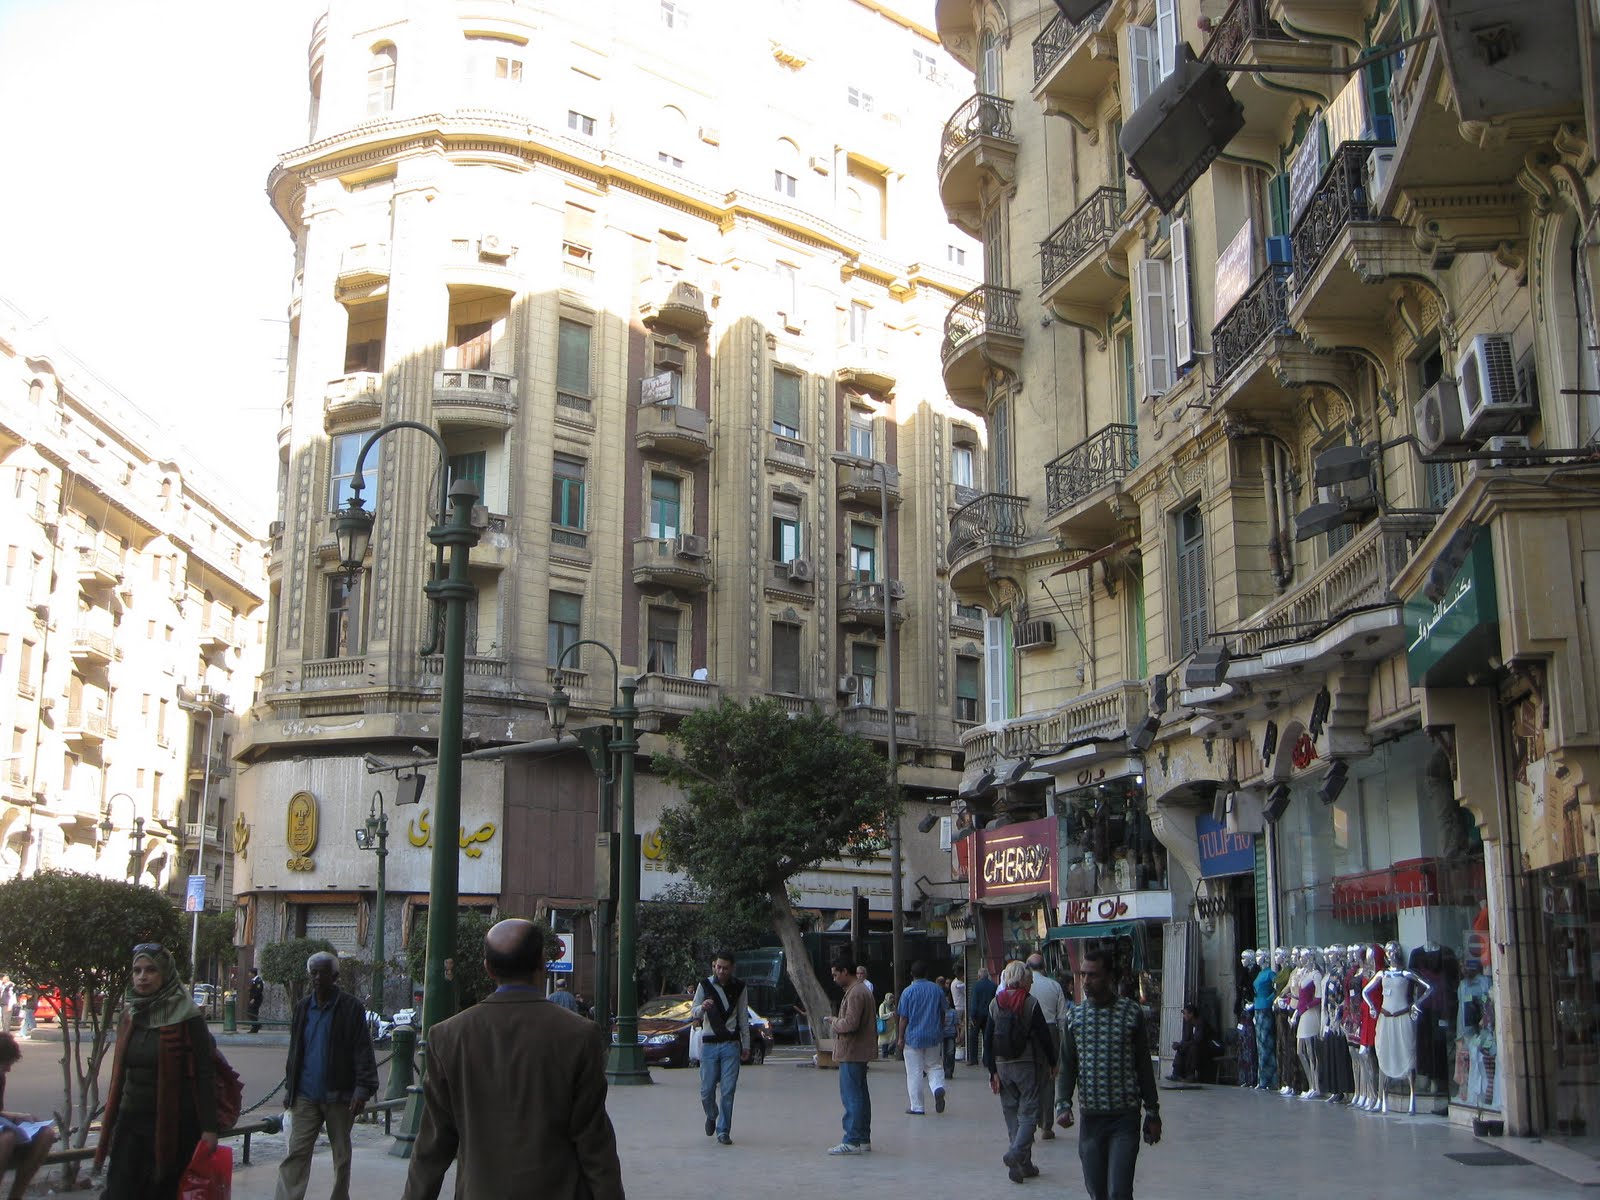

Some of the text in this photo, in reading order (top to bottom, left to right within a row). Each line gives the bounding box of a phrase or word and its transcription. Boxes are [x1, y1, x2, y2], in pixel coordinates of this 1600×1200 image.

[1443, 577, 1472, 615] مكتبة
[1200, 828, 1231, 859] TULIP
[983, 843, 1050, 883] CHERRY
[1065, 898, 1093, 924] AREF
